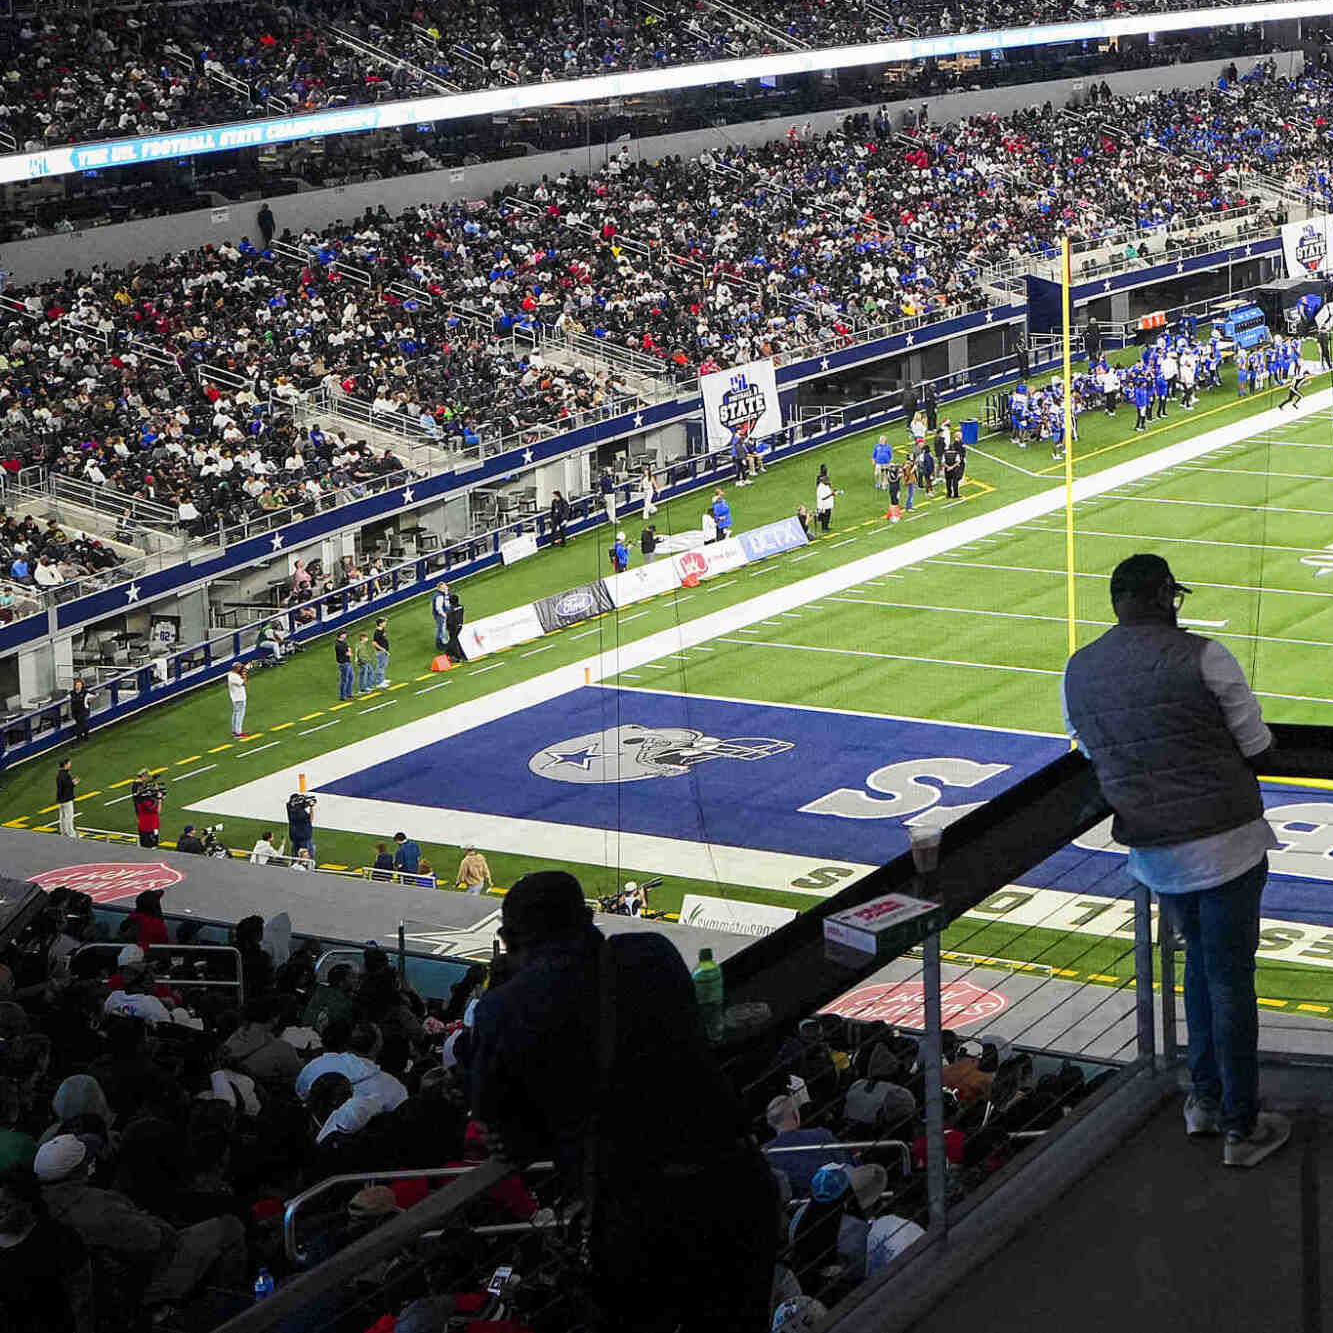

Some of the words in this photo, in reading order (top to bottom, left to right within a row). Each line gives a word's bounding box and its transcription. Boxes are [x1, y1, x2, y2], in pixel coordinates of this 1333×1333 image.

[77, 149, 109, 168] THE
[141, 132, 216, 160] FOOTBALL
[219, 126, 263, 148] STATE
[1296, 241, 1327, 260] STATE
[719, 392, 766, 423] STATE
[561, 594, 588, 614] Ford
